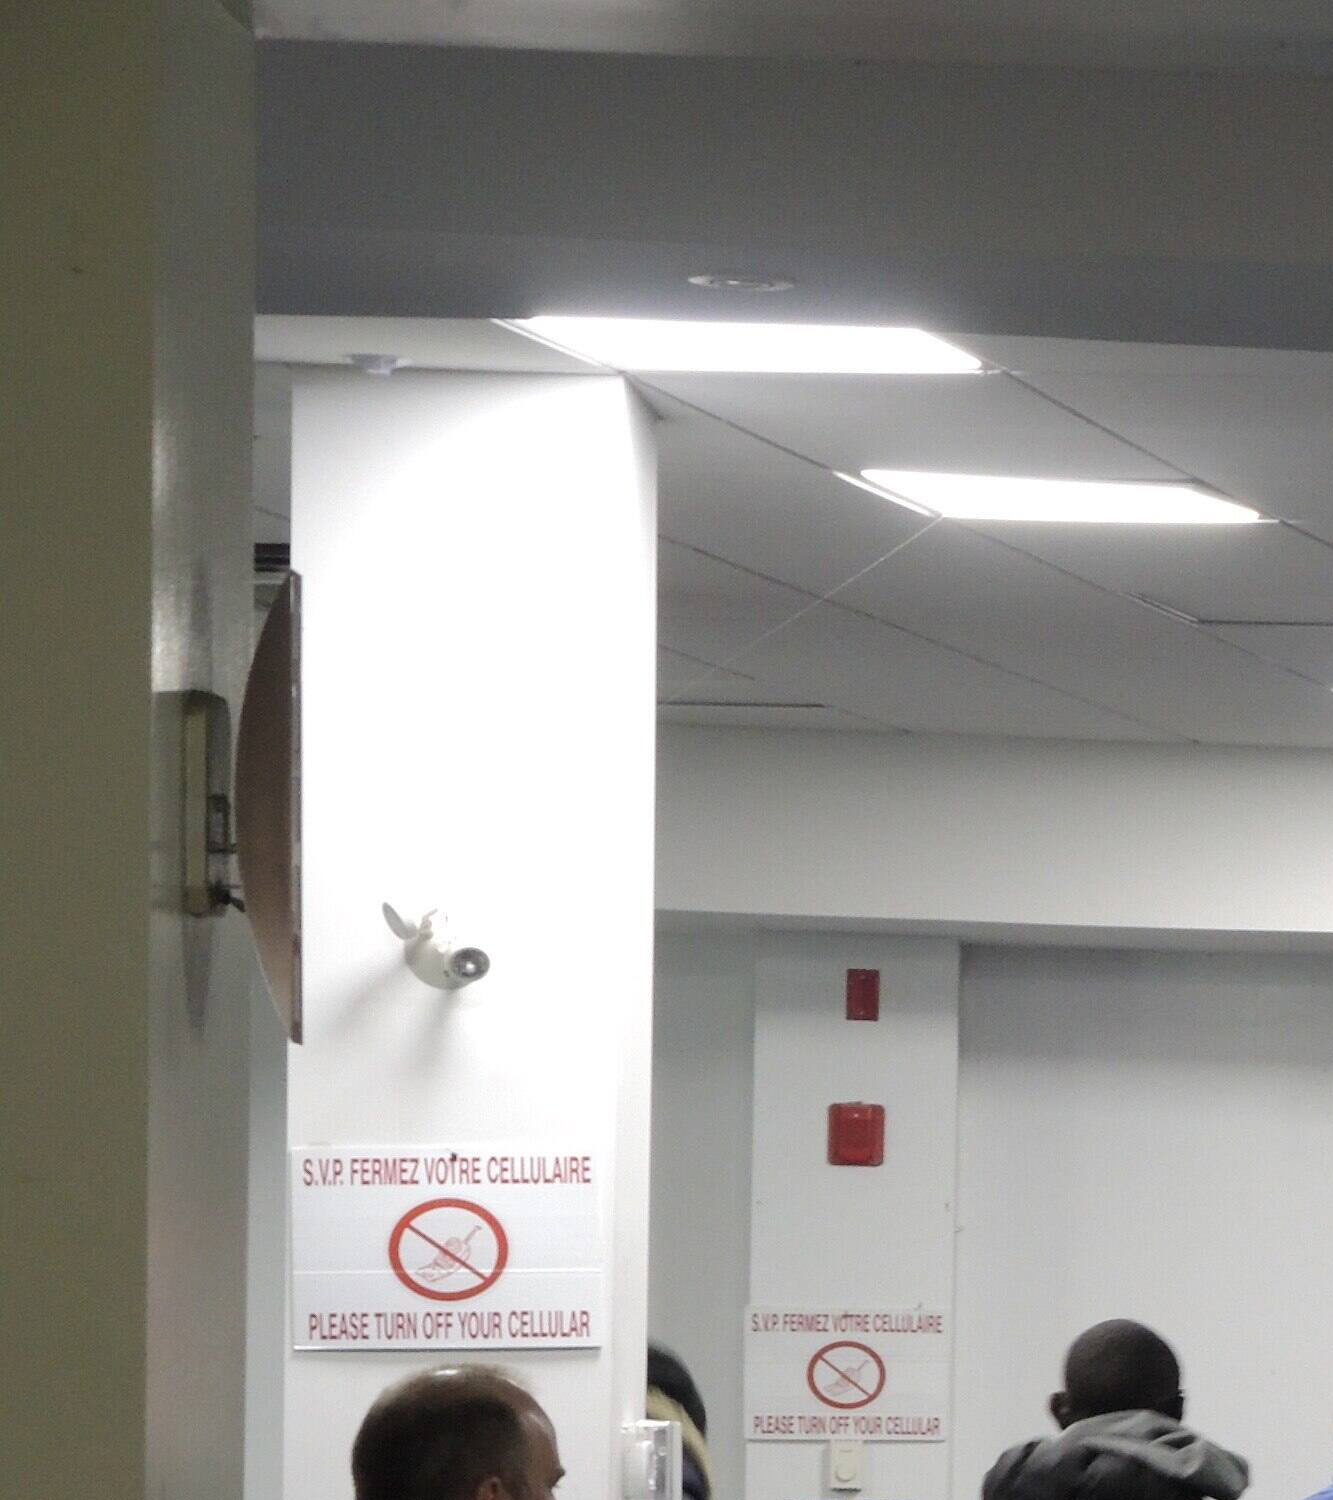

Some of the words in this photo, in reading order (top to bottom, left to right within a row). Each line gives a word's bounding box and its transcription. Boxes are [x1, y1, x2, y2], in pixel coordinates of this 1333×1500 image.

[303, 1158, 344, 1186] S.V.P.
[350, 1158, 419, 1185] FERMEZ
[487, 1156, 591, 1183] CELLULAIRE
[309, 1313, 369, 1341] PLEASE
[374, 1312, 417, 1340] TURN
[422, 1312, 453, 1339] OFF
[458, 1311, 502, 1339] YOUR
[508, 1310, 591, 1338] CELLULAR
[783, 1313, 829, 1332] FERMEZ
[873, 1313, 943, 1334] CELLULAIRE
[754, 1416, 794, 1435] PLEASE
[798, 1416, 826, 1435] TURN
[831, 1416, 849, 1434] OFF
[852, 1416, 881, 1435] YOUR
[887, 1416, 940, 1436] CELLULAR
